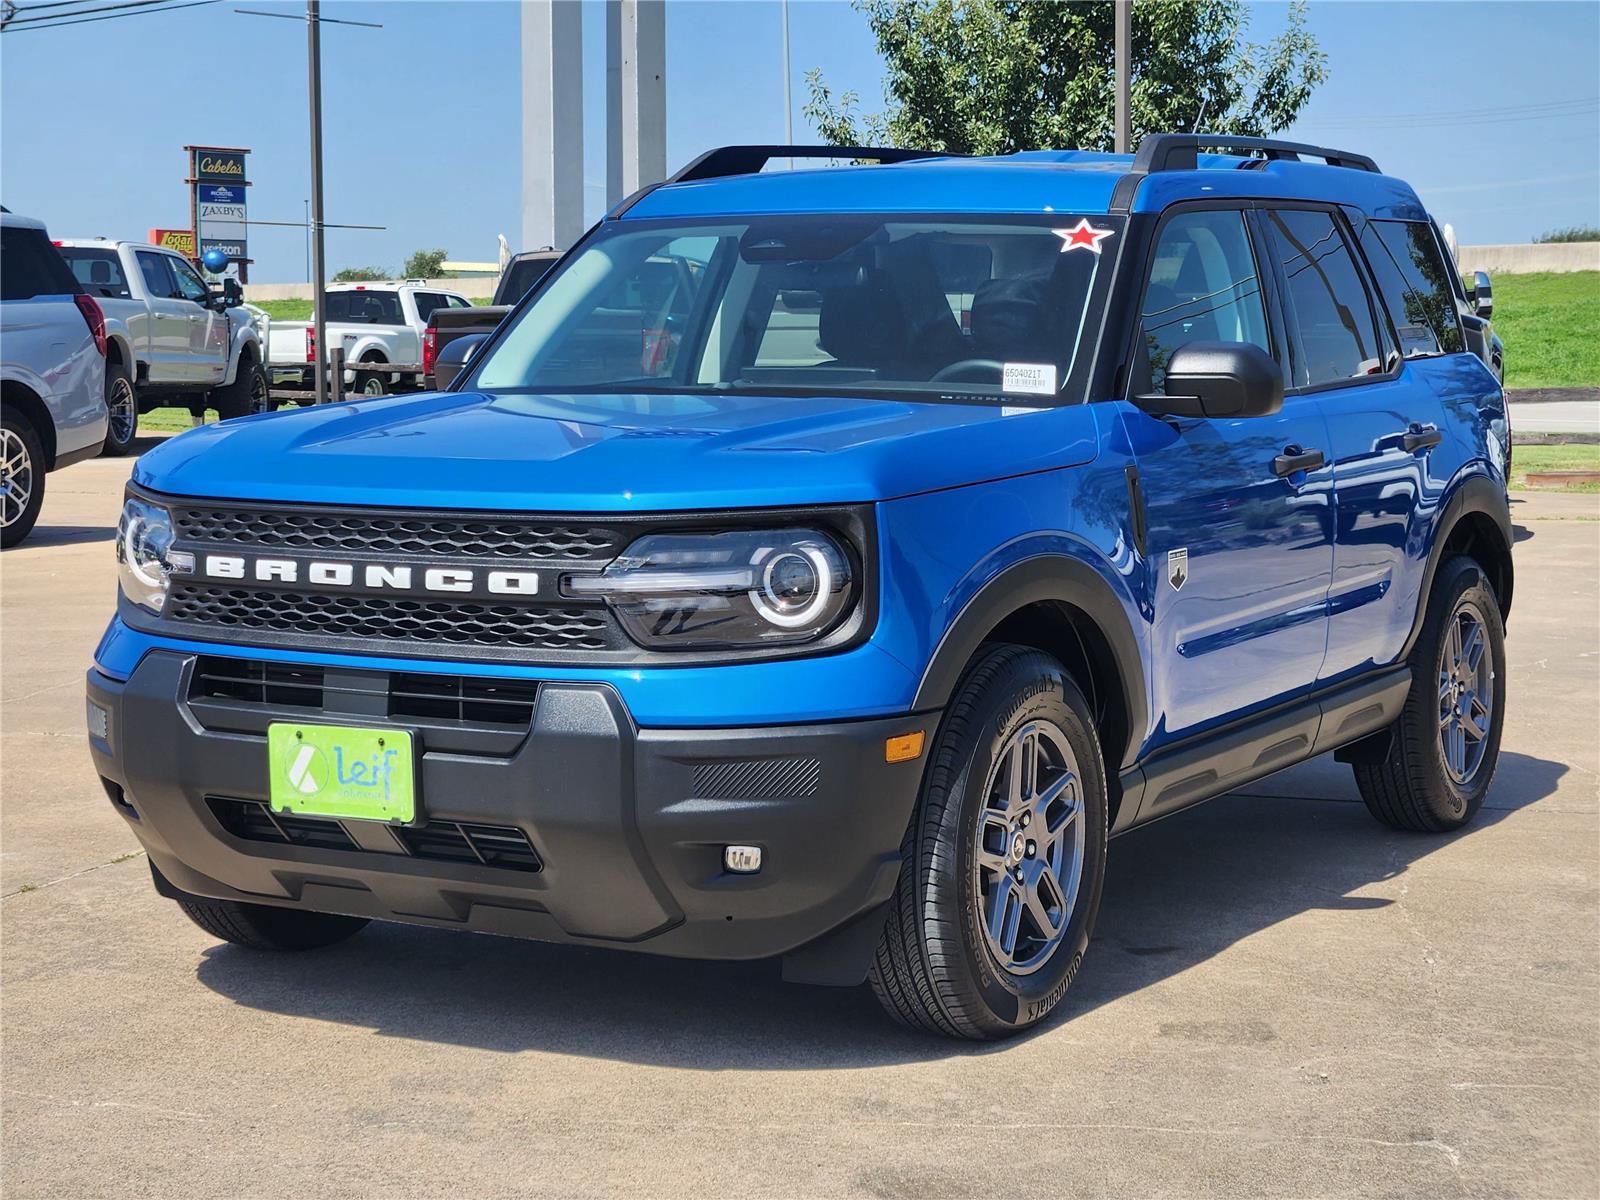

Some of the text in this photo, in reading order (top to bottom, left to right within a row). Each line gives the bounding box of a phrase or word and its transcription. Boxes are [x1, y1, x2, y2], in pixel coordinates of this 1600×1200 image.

[201, 157, 242, 174] Cabela's
[202, 205, 244, 218] ZAXBY'S
[206, 556, 539, 595] BRONCO
